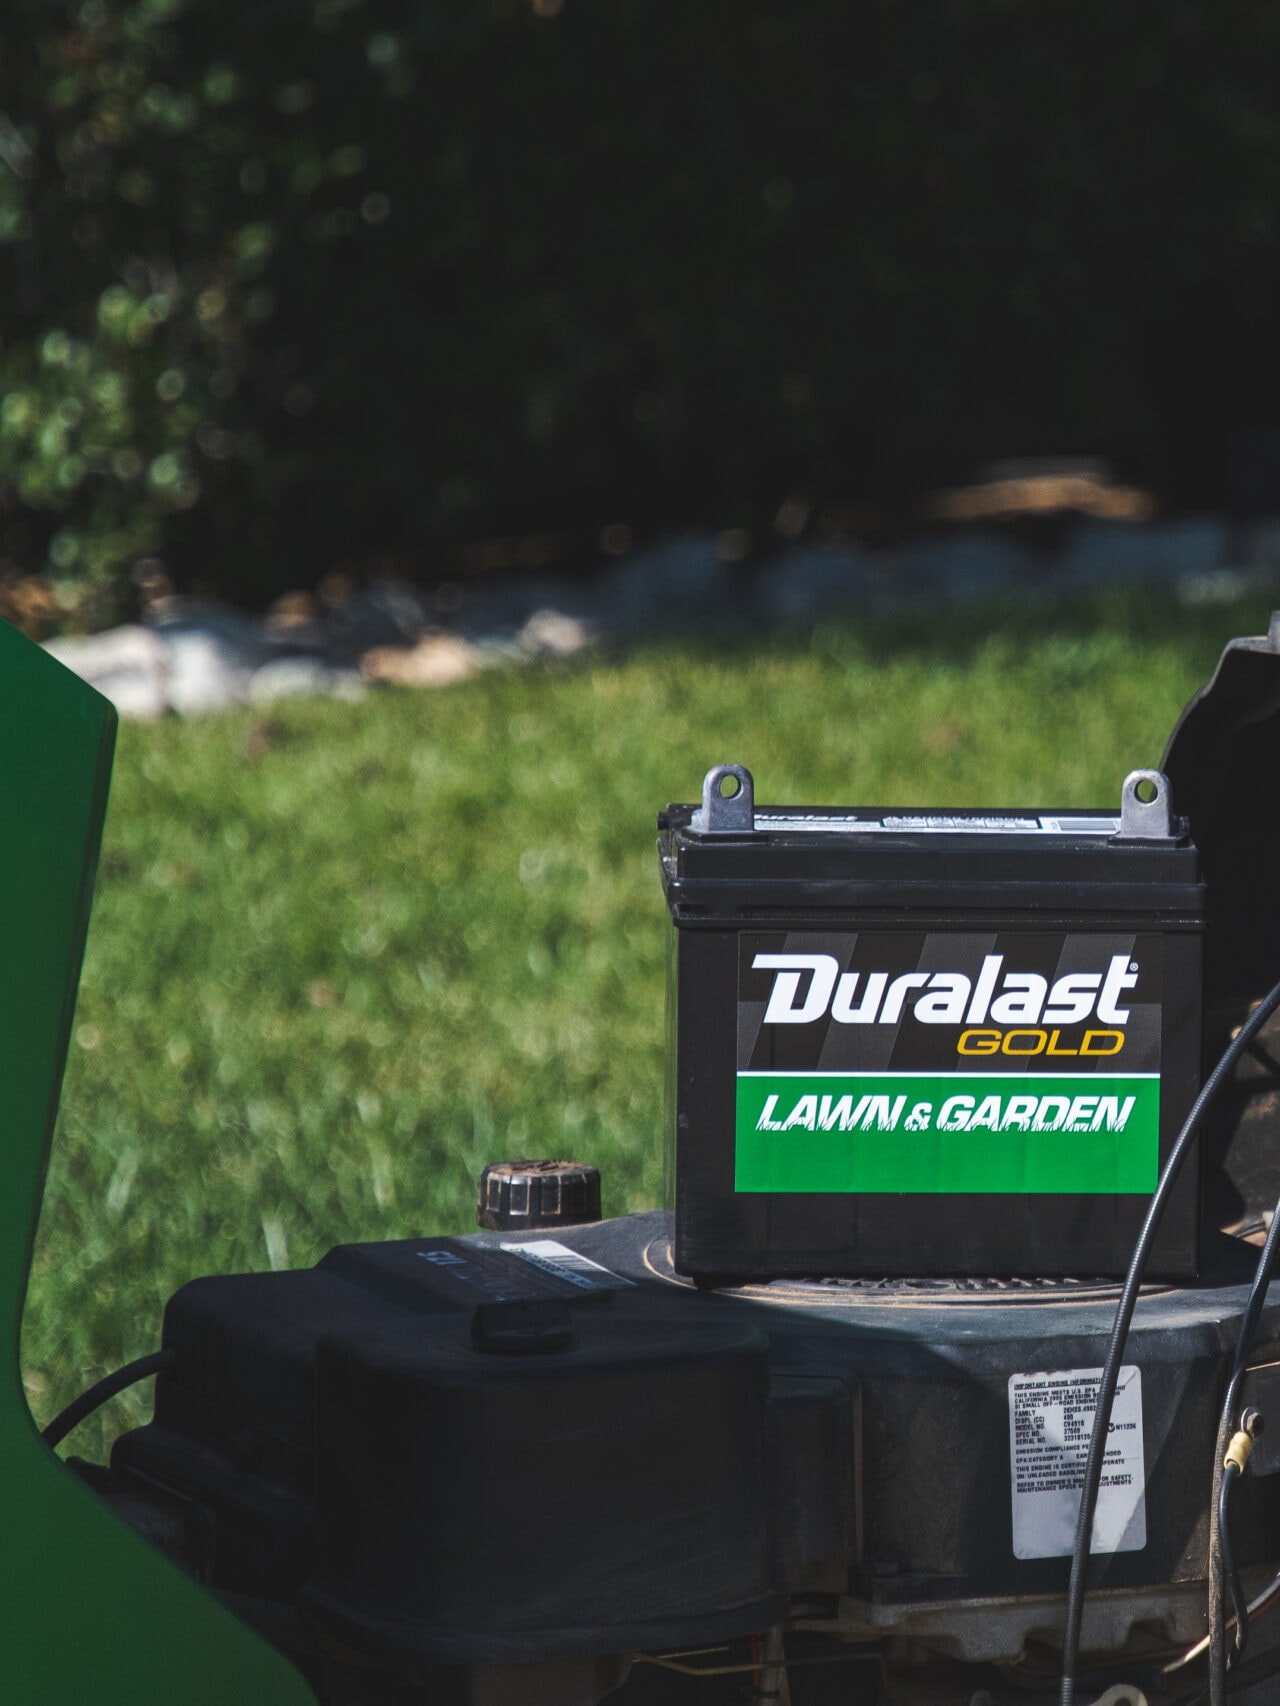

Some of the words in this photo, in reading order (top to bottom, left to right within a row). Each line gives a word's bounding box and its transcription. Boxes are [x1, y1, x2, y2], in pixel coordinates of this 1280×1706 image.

[957, 1029, 1125, 1056] GOLD
[755, 1095, 907, 1132] LAWN
[904, 1101, 931, 1131] &
[936, 1095, 1136, 1133] GARDEN
[1014, 1381, 1046, 1390] IMPORTANT
[1048, 1380, 1068, 1388] ENGINE
[1070, 1377, 1103, 1386] INFORMATI
[1014, 1396, 1048, 1404] CALIFORNIA
[1014, 1409, 1036, 1417] FAMILY
[1033, 1416, 1045, 1425] (CC)
[1015, 1423, 1034, 1431] MODEL
[1015, 1438, 1035, 1446] SERIAL
[1016, 1447, 1043, 1455] EMISSION
[1044, 1444, 1080, 1453] COMPLIANCE
[1027, 1470, 1057, 1479] UNLEADED
[1017, 1485, 1057, 1493] MAINTENANCE
